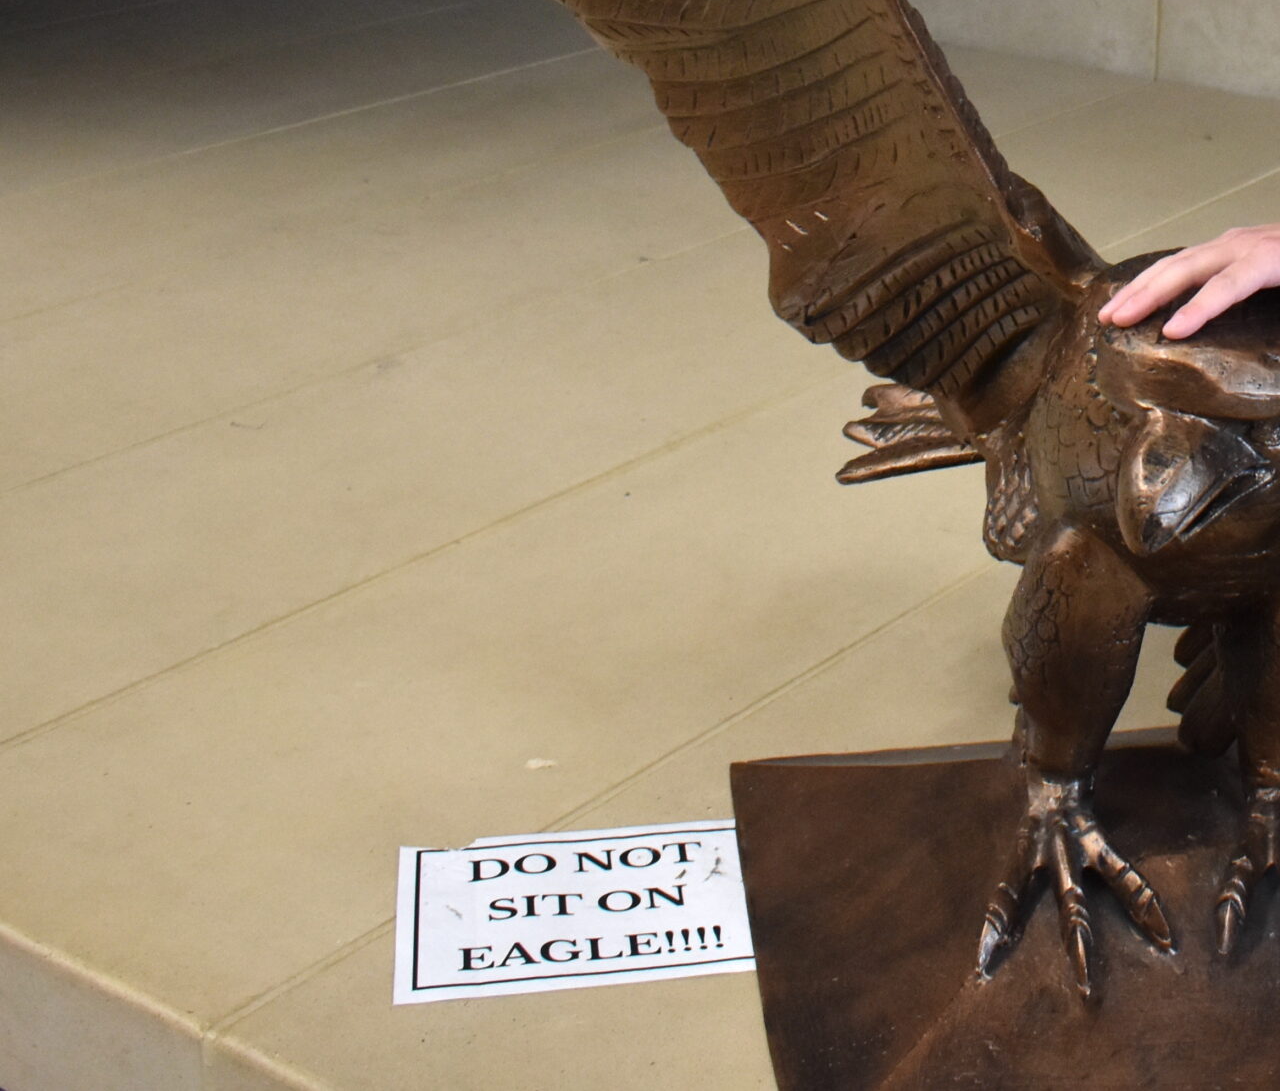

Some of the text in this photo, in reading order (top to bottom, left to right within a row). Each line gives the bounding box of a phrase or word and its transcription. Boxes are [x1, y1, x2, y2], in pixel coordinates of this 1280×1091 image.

[468, 841, 701, 882] DO NOT
[488, 884, 687, 921] SIT ON
[457, 925, 724, 971] EAGLE!!!!
